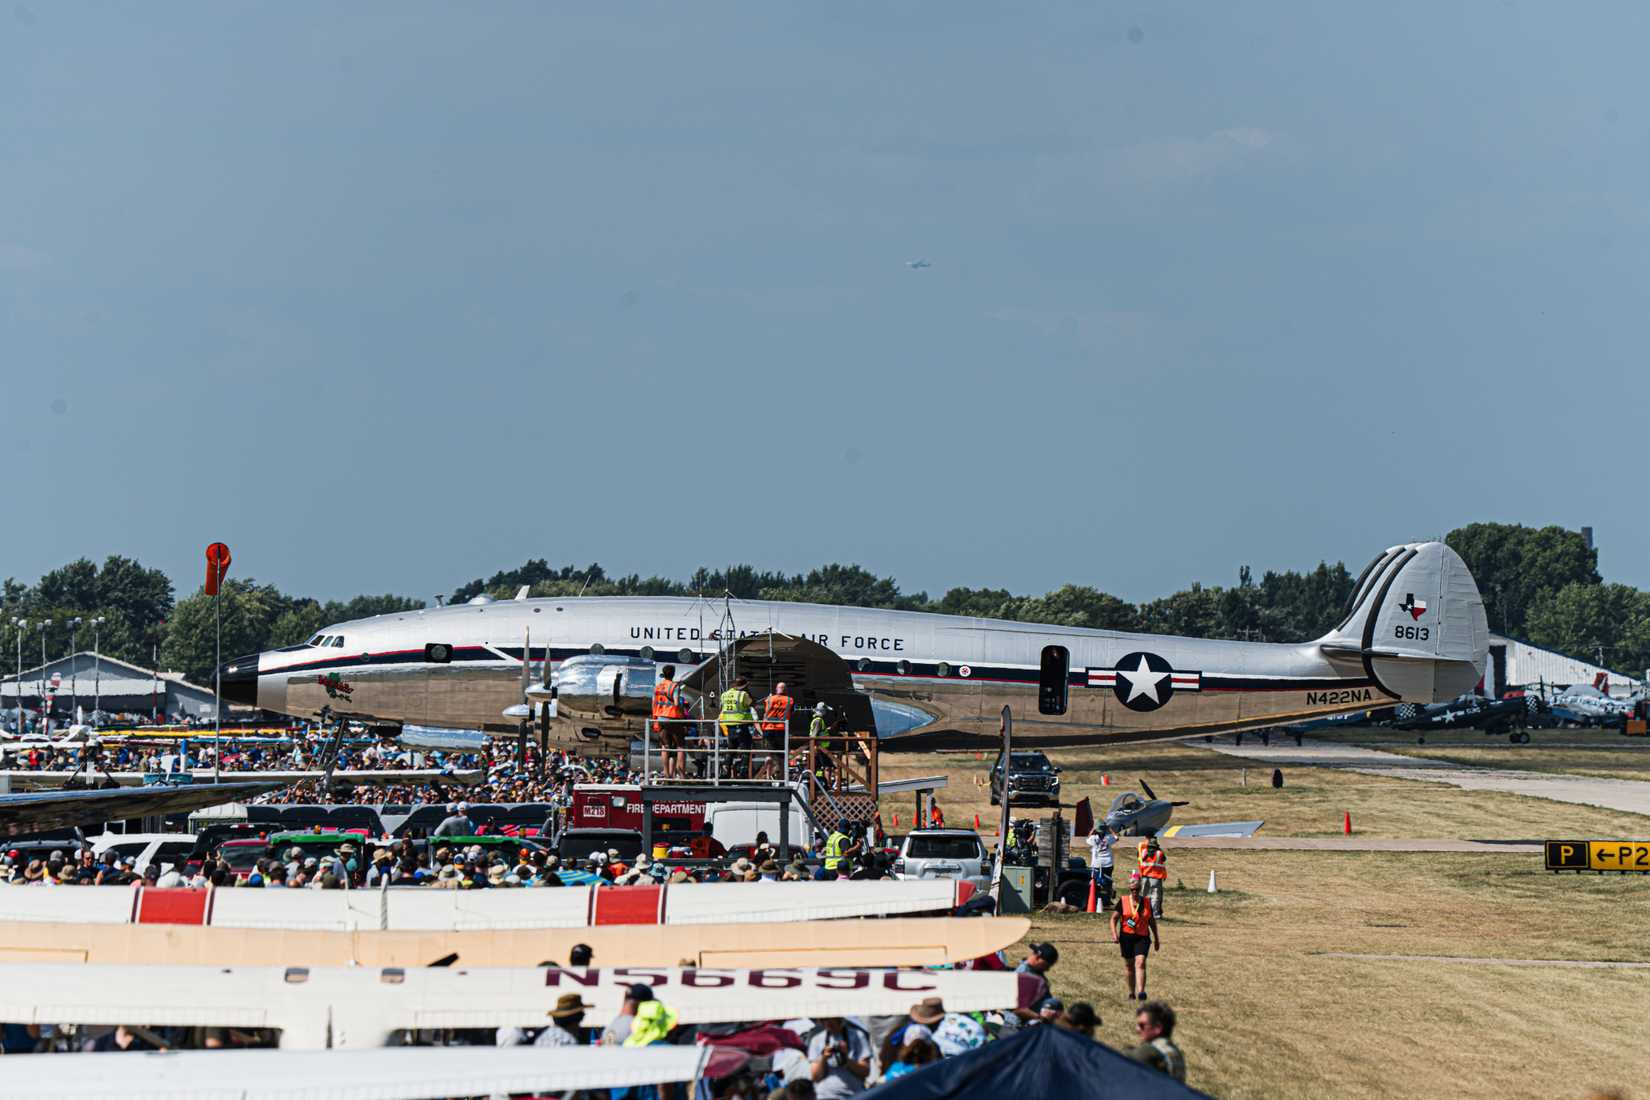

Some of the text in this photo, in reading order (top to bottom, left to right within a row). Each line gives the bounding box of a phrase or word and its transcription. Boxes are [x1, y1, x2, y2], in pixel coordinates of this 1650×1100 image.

[630, 626, 700, 640] UNITED
[841, 635, 904, 651] FORCE
[1395, 625, 1430, 641] 8613
[1306, 688, 1372, 705] N422NA
[652, 804, 706, 814] EPARTMENT
[1560, 845, 1574, 865] P
[1618, 846, 1650, 866] P2
[545, 967, 938, 991] N5669C
